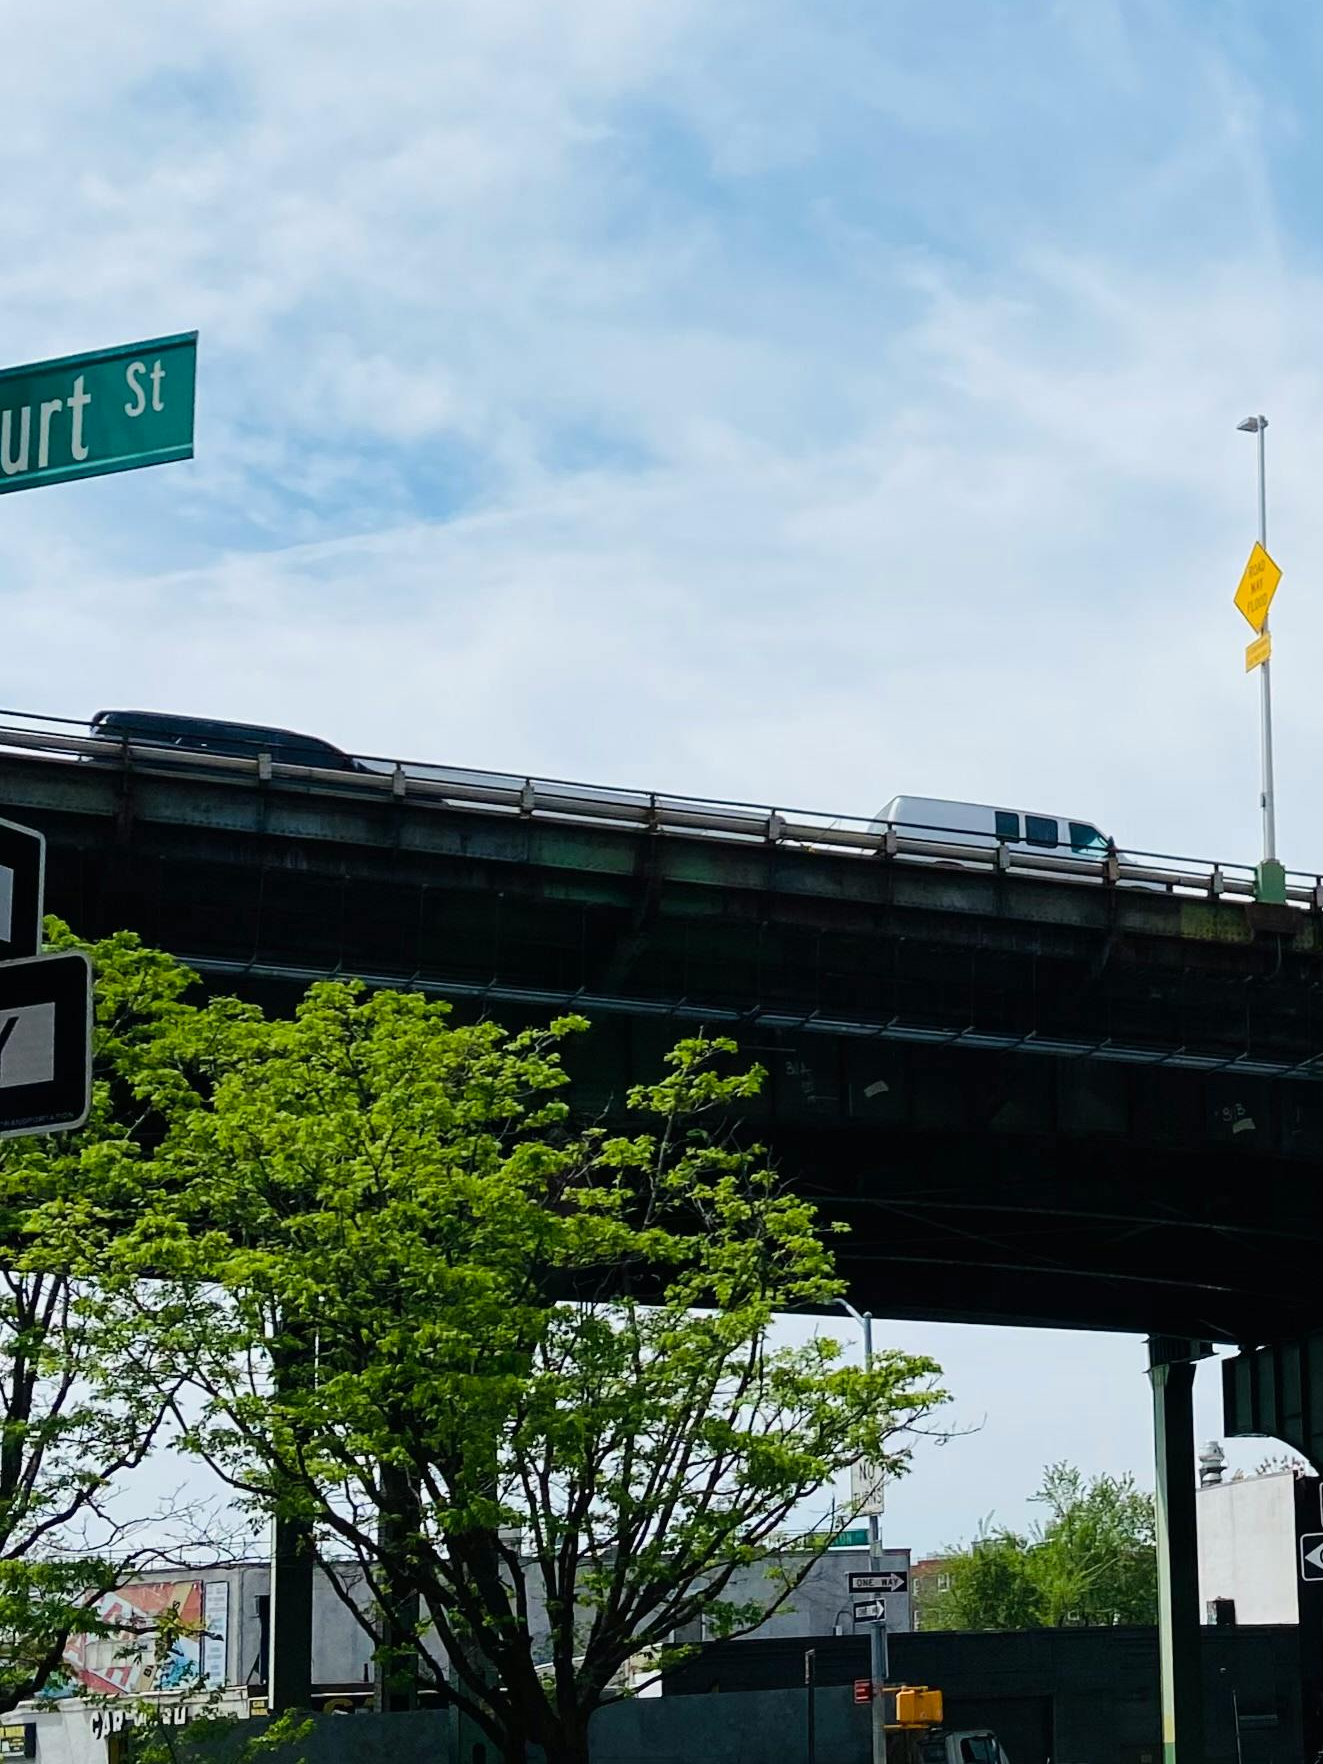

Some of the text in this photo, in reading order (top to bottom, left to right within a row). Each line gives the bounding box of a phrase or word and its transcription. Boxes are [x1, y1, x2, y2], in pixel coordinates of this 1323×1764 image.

[124, 359, 166, 417] St
[859, 1461, 876, 1481] NO
[856, 1578, 899, 1587] ONE WAY
